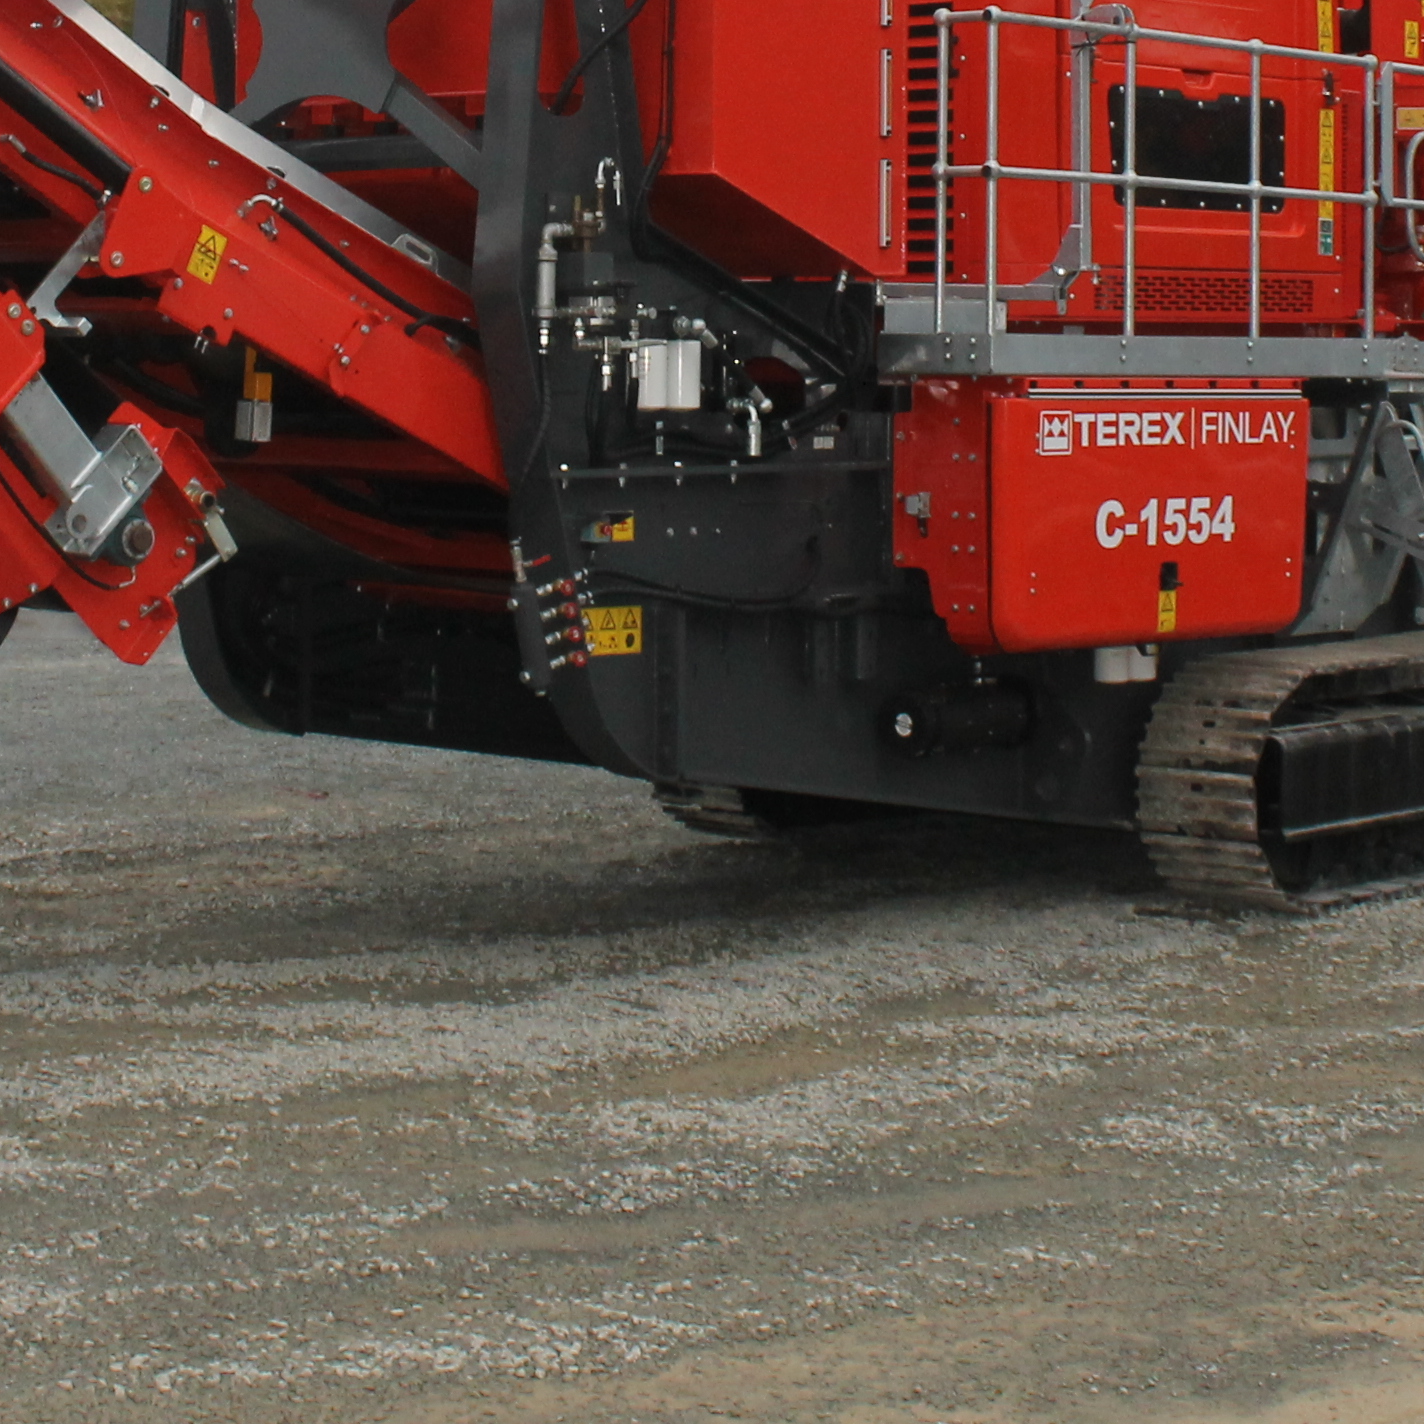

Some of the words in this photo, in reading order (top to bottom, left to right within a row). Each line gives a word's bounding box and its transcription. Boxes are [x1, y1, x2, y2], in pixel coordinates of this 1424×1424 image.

[1073, 412, 1185, 447] TEREX
[1201, 411, 1295, 444] FINLAY
[1095, 495, 1236, 549] C-1554
